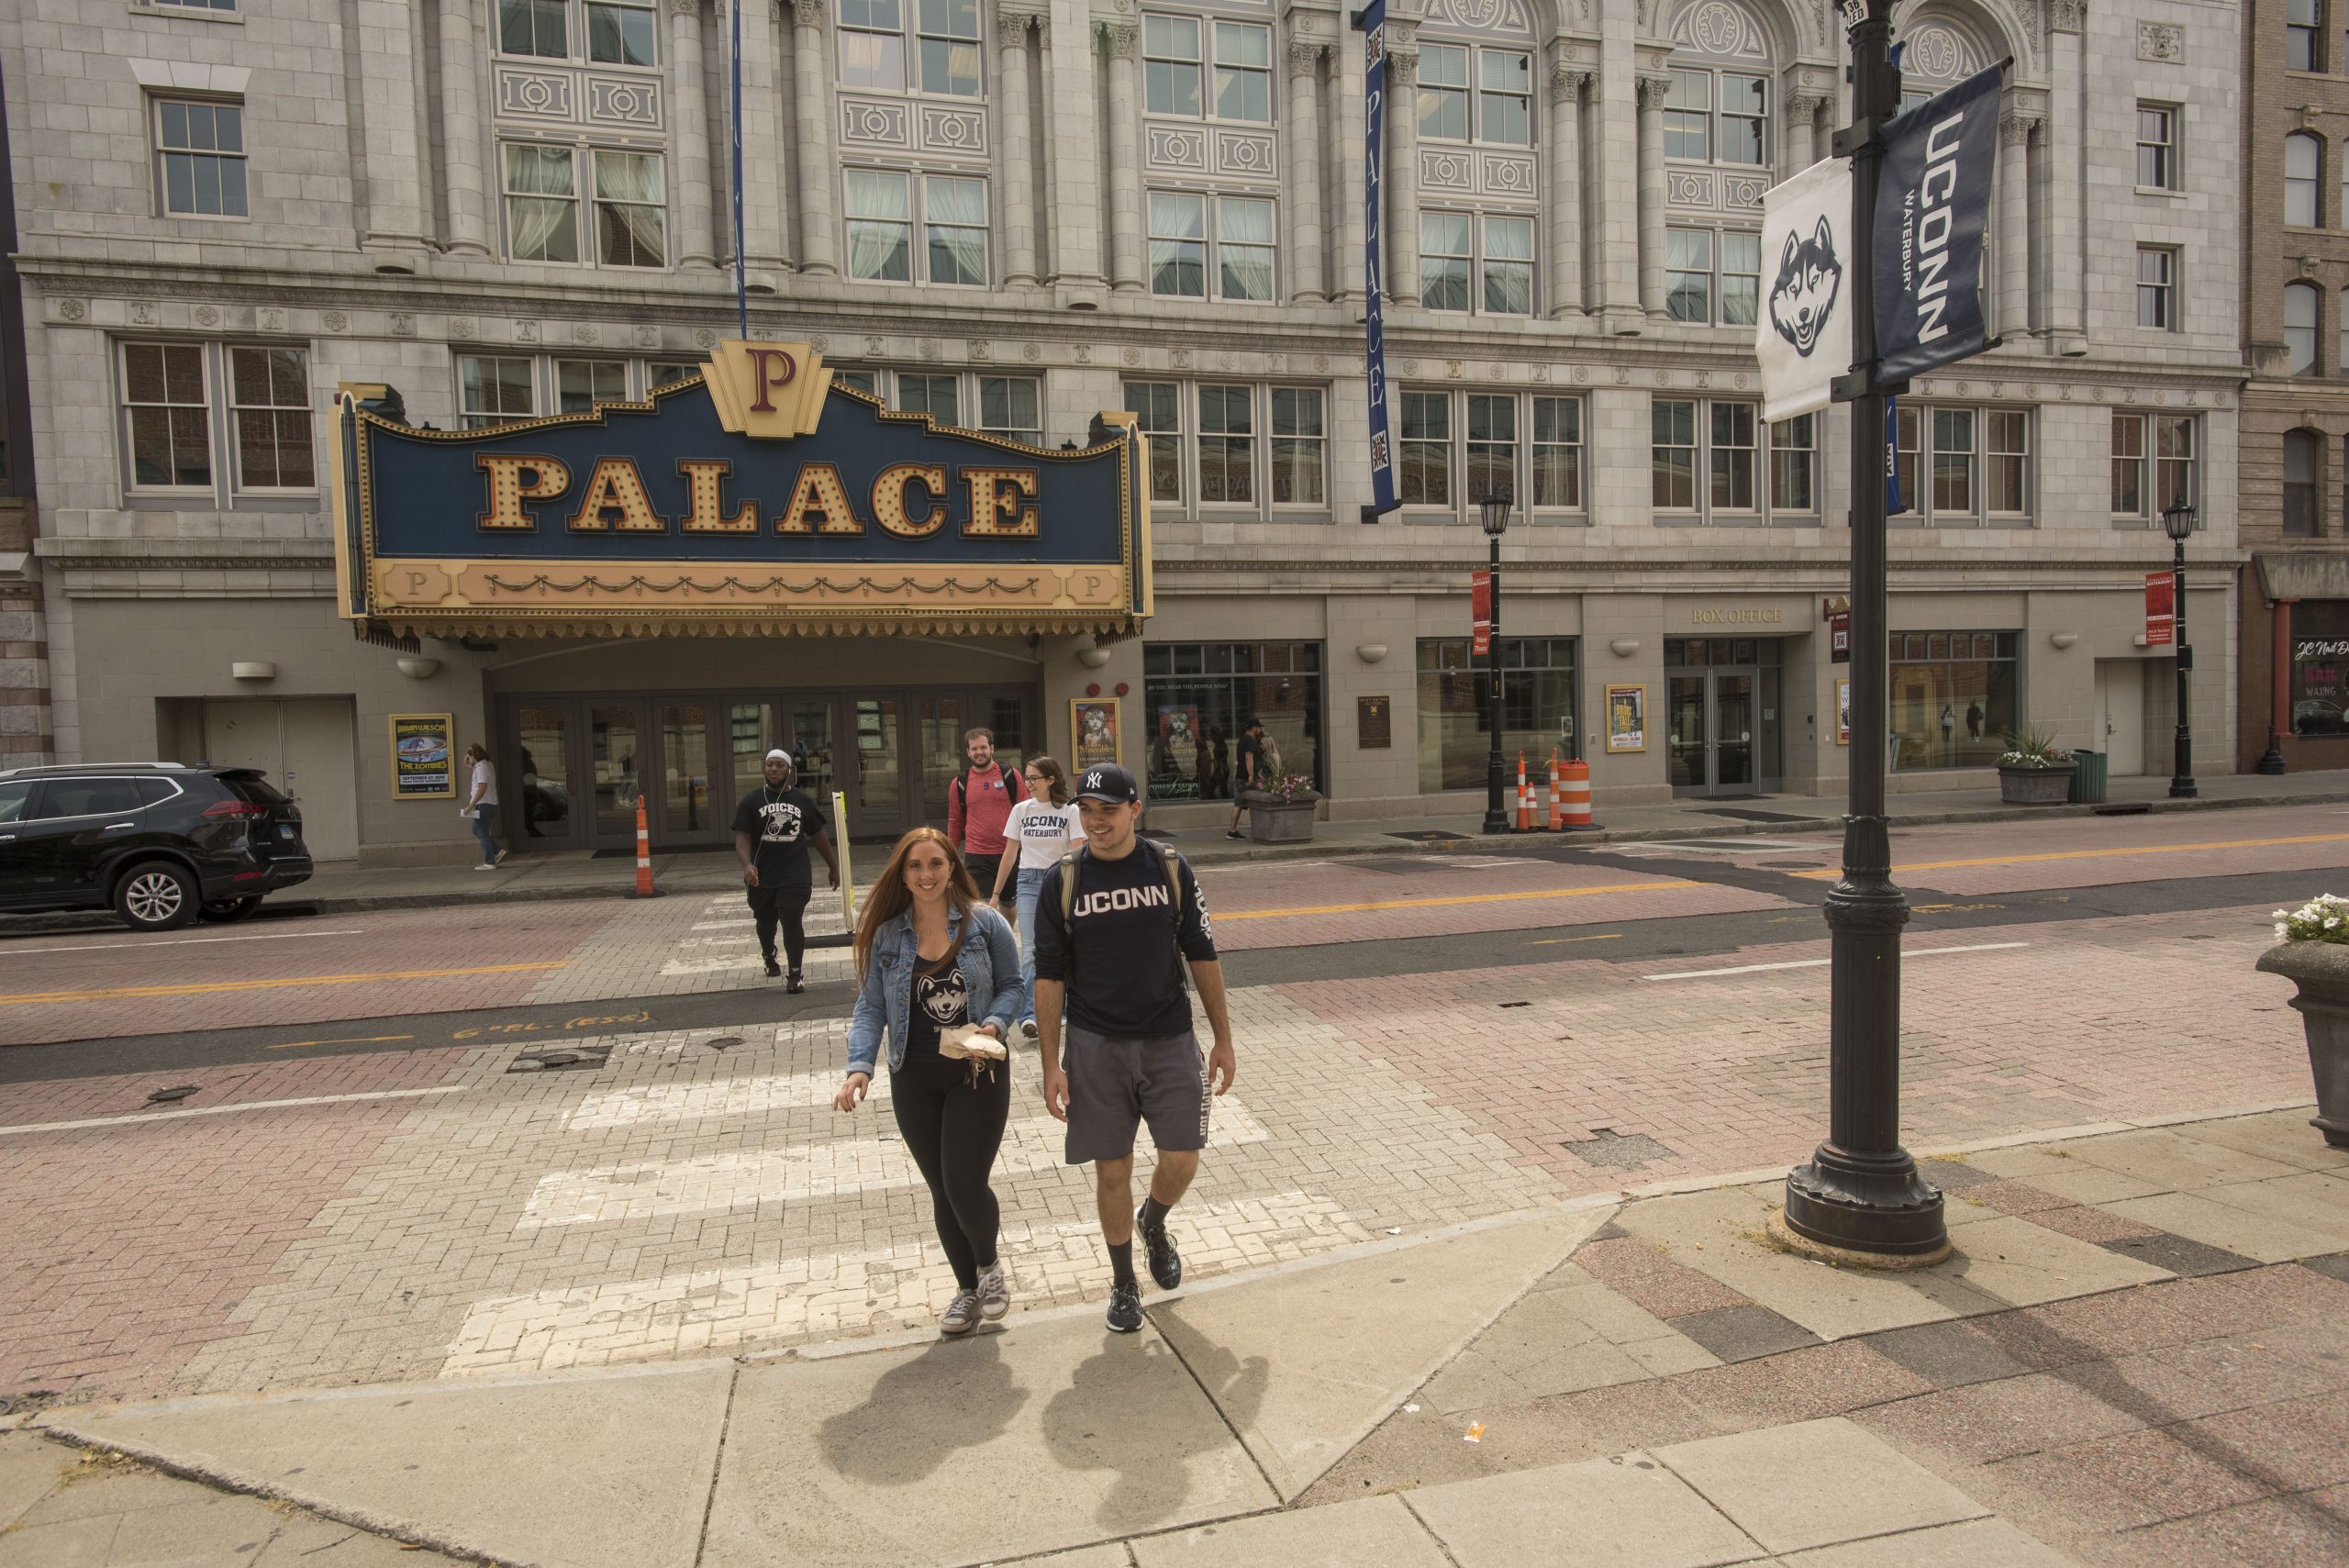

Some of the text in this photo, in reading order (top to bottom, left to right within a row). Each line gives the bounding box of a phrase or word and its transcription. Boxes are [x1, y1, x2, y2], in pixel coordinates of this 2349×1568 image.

[1848, 0, 1861, 13] 36
[1849, 8, 1865, 26] LED
[1917, 110, 1964, 345] UCONN
[1367, 89, 1384, 409] PALACE
[1902, 188, 1915, 292] WATERBURY
[745, 348, 796, 412] P
[476, 451, 1041, 539] PALACE
[406, 572, 428, 595] P
[1085, 575, 1101, 597] P
[1692, 609, 1783, 624] BOX OFFICE
[2295, 641, 2315, 661] JC
[2315, 641, 2338, 655] Nail
[2306, 686, 2336, 697] WAXING
[397, 725, 417, 733] BRIAN
[417, 724, 446, 732] WILSON
[1086, 772, 1103, 789] NY
[759, 802, 802, 817] VOICES
[789, 819, 801, 836] 3
[1021, 816, 1068, 828] UCONN
[1023, 828, 1063, 838] WATERBURY
[1074, 884, 1169, 917] UCONN
